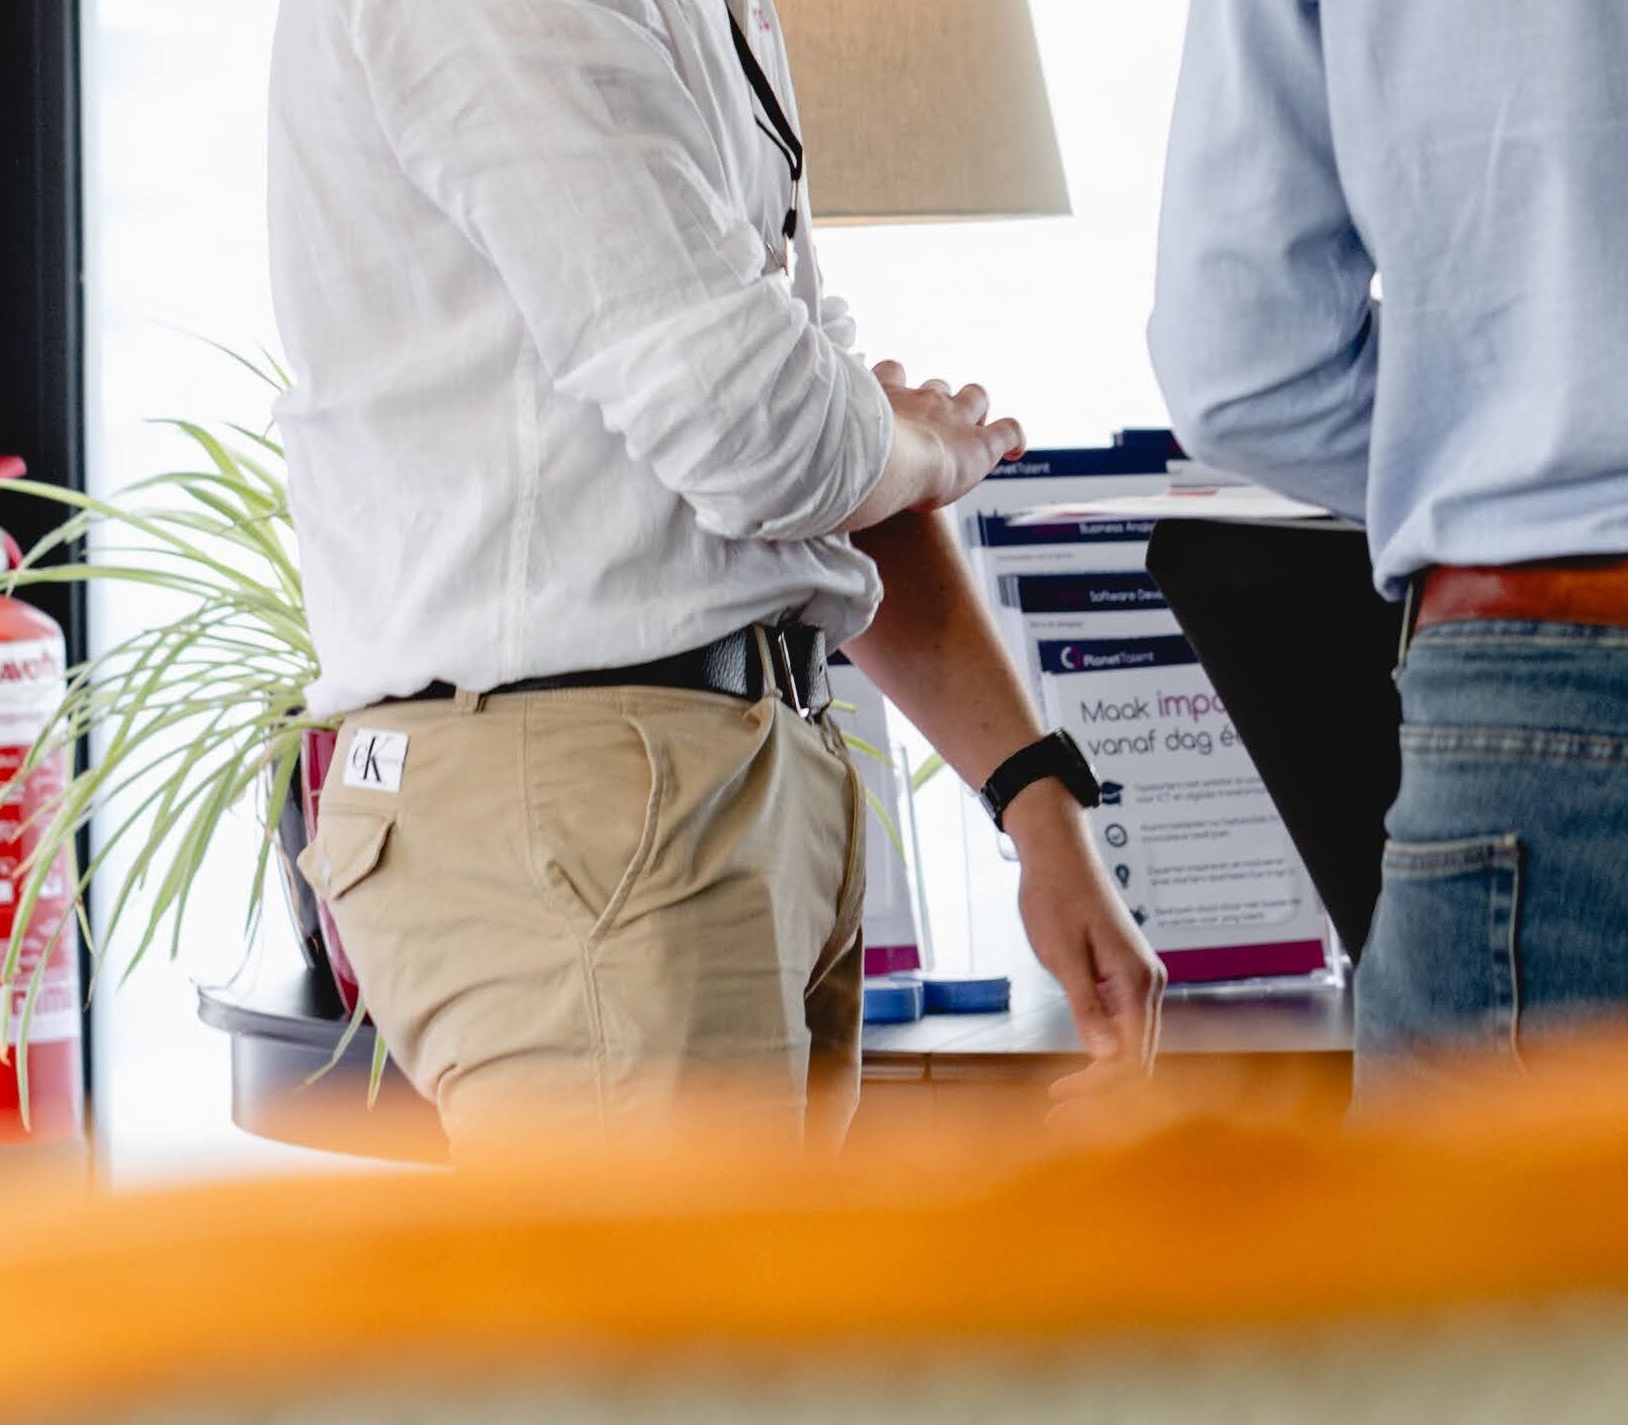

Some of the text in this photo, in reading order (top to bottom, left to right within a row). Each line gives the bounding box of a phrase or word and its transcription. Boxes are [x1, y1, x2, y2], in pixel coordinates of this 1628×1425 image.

[1080, 696, 1150, 724] Maak
[1087, 728, 1157, 757] vanaf
[1164, 727, 1213, 756] dag
